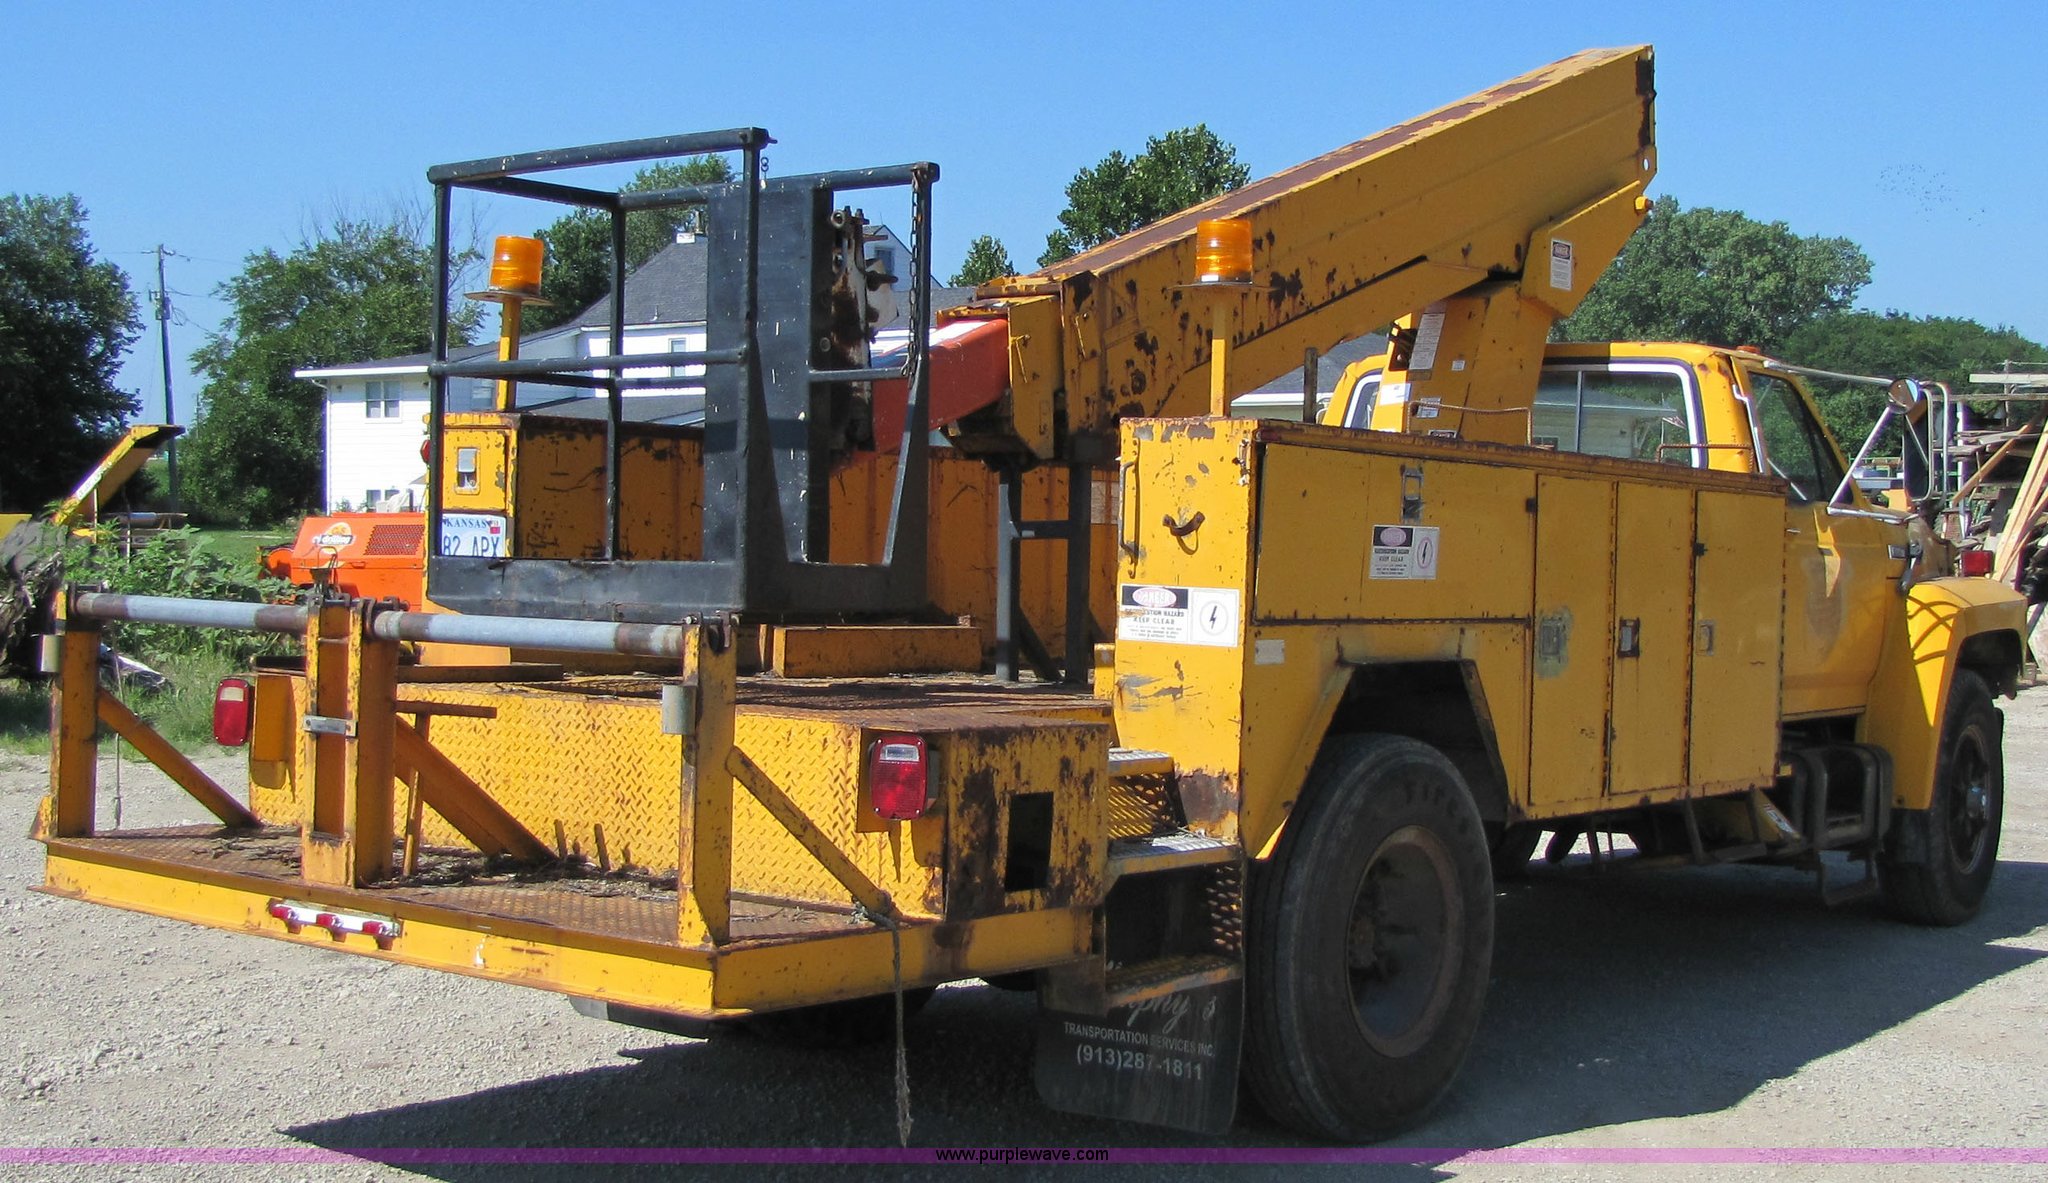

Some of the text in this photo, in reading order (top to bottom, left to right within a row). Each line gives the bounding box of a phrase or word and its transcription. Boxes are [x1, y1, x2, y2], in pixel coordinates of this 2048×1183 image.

[447, 518, 486, 528] KANSAS
[1133, 616, 1149, 624] KEEP
[1063, 1021, 1216, 1058] TRANSPORTATION SERVICES INC.
[1076, 1044, 1202, 1080] (913)287-1811
